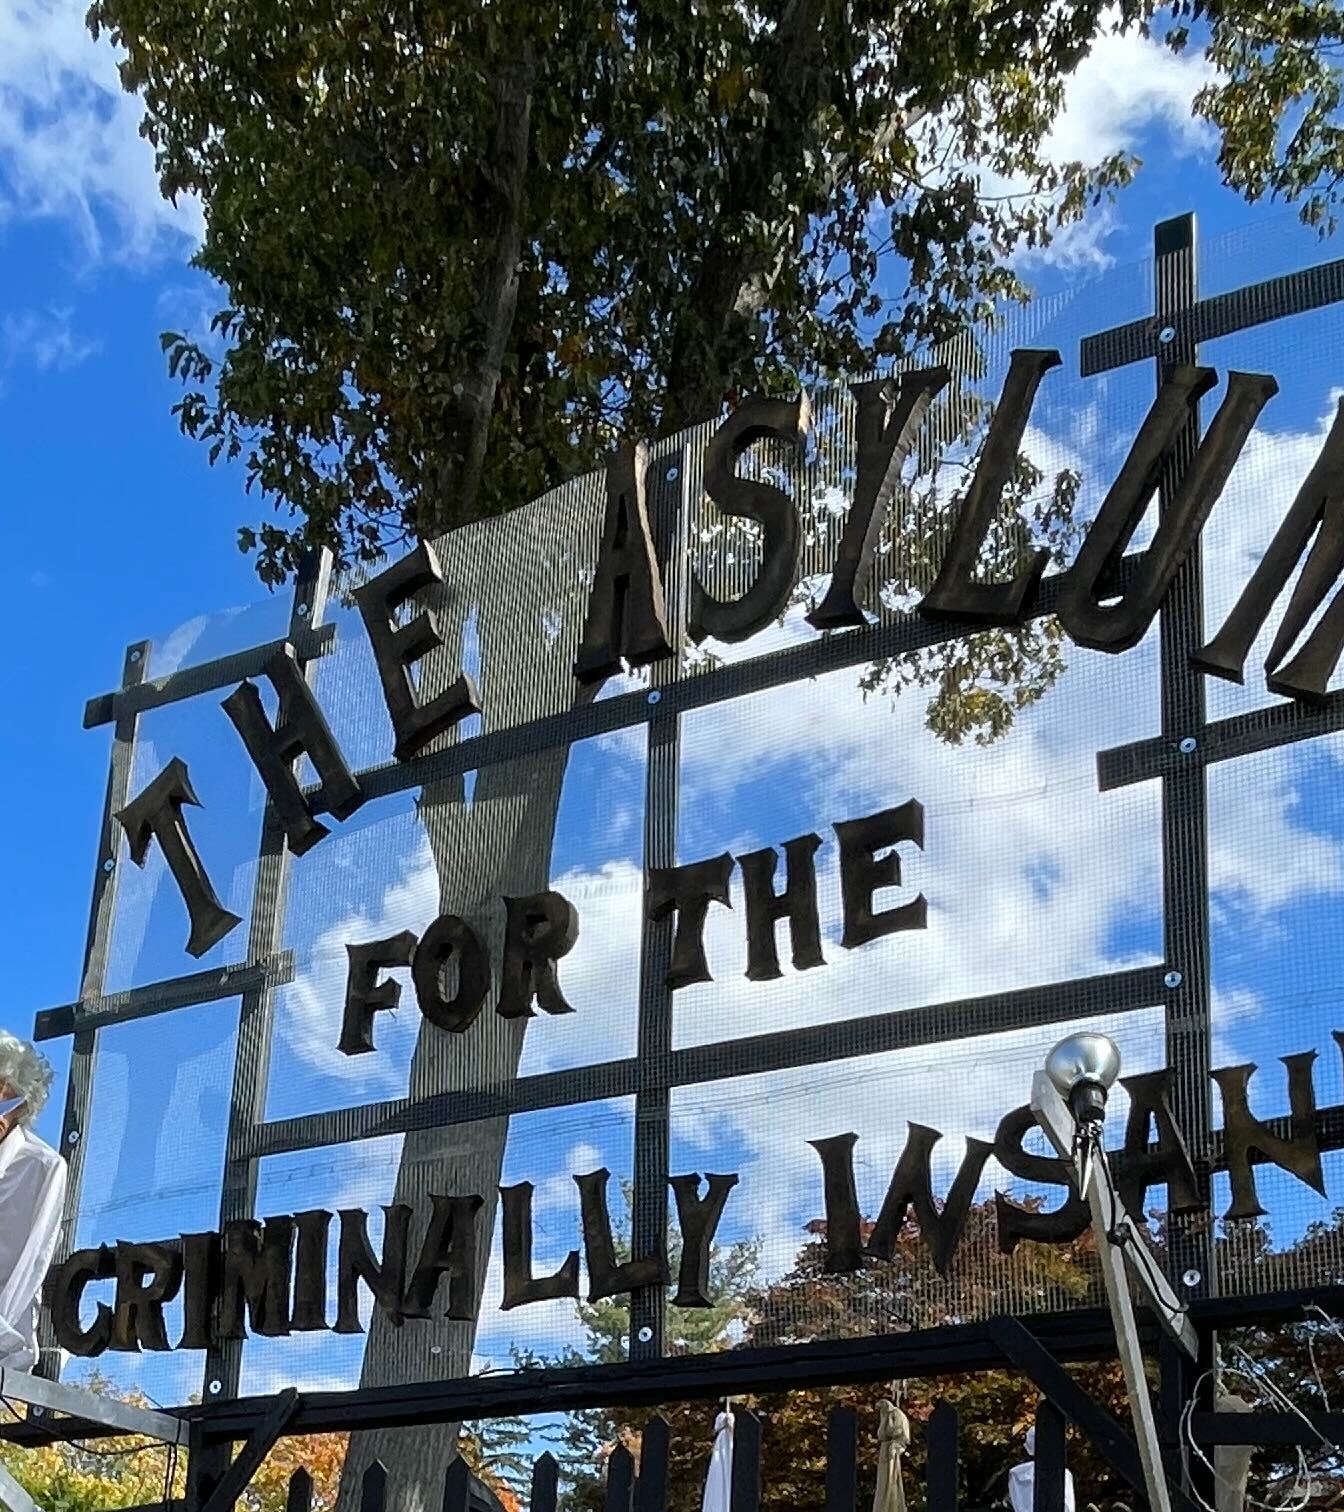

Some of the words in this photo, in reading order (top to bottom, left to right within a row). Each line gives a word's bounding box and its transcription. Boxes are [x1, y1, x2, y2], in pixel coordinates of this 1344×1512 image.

[114, 539, 482, 958] THE
[336, 890, 579, 1055] FOR
[648, 797, 928, 990] THE
[53, 1168, 740, 1359] CRIMINALLY
